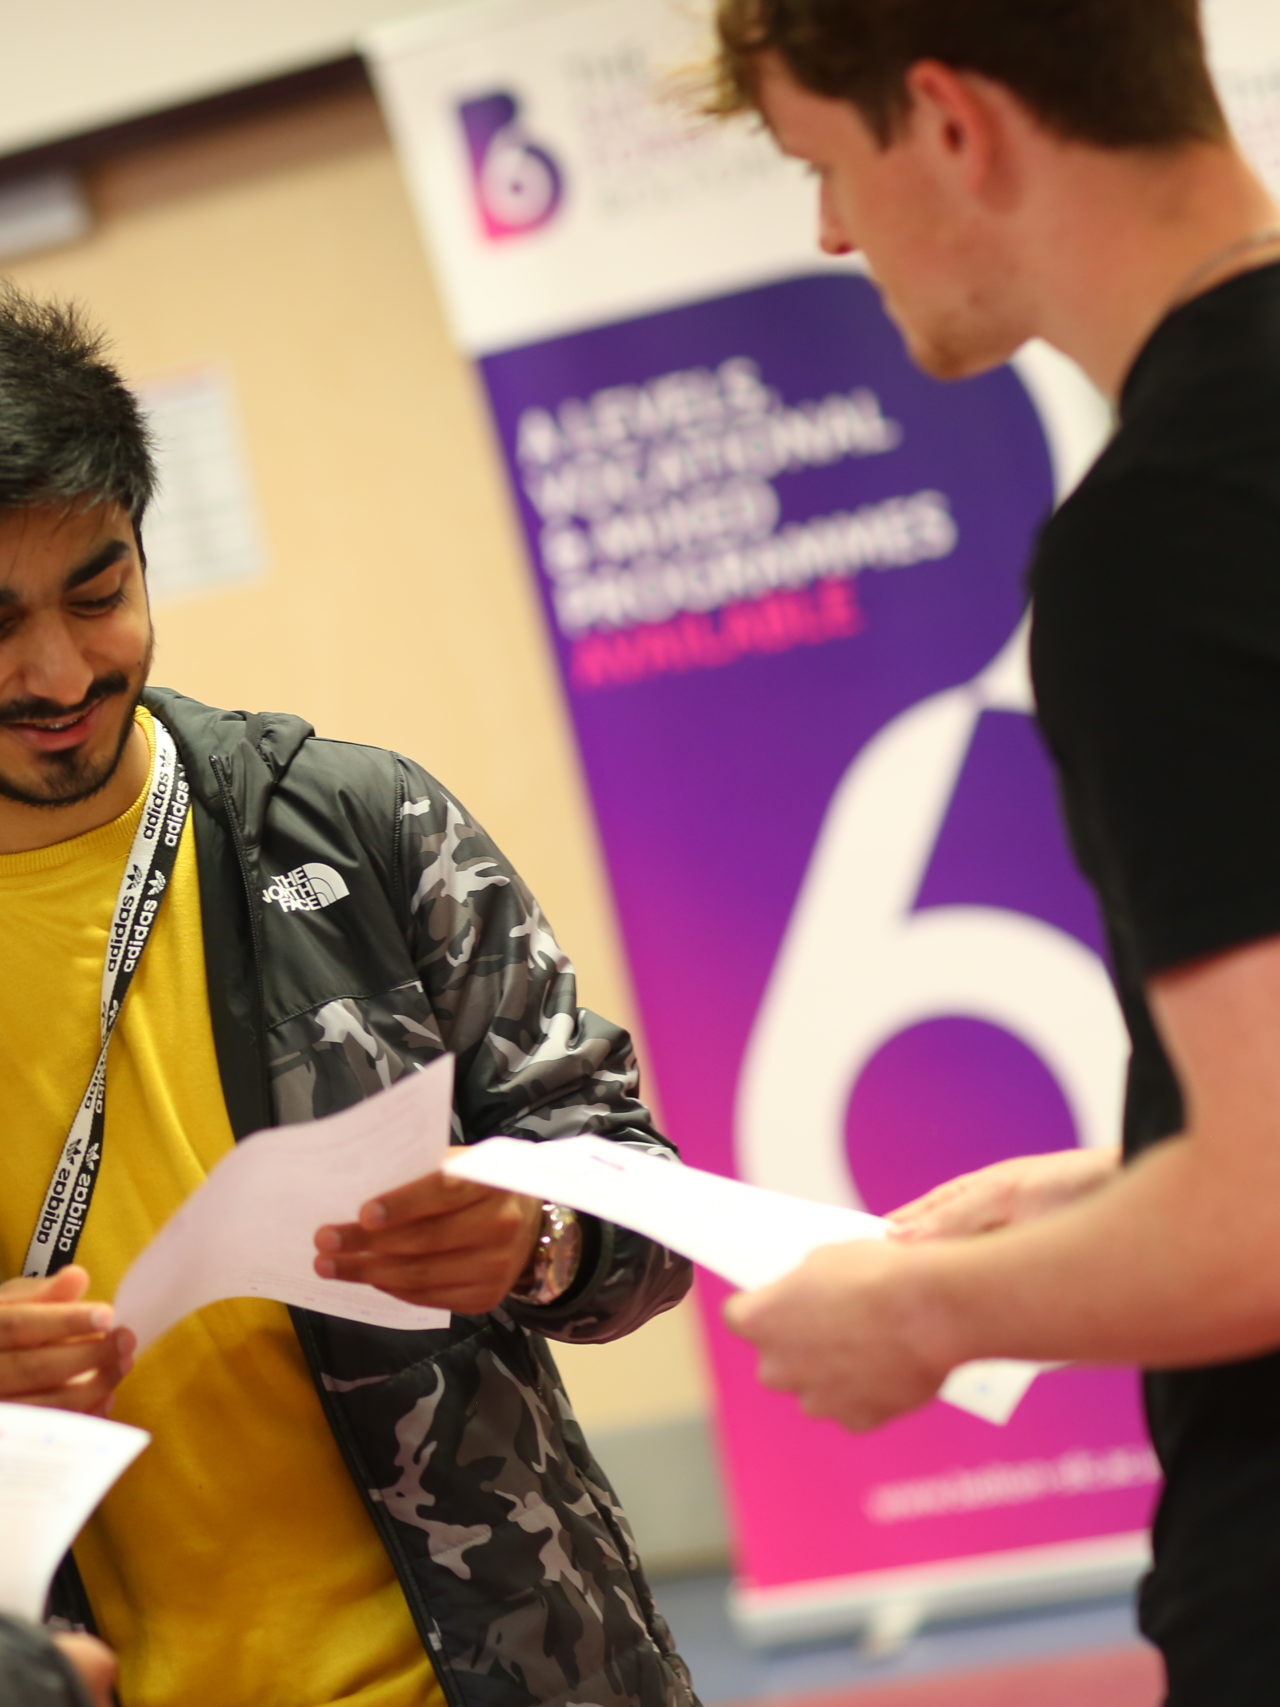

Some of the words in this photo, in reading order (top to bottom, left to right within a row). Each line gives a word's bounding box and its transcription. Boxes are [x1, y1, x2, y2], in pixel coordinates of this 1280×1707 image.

[524, 388, 902, 521] VOCATIONAL
[589, 474, 781, 567] MIXED
[552, 489, 959, 637] PROGRAMMES
[571, 573, 864, 692] AVAILABLE
[141, 769, 170, 841] adidas
[164, 778, 191, 848] adidas
[271, 866, 308, 888] THE
[278, 895, 322, 913] FACE
[106, 894, 134, 973] adidas
[122, 898, 159, 974] adidas
